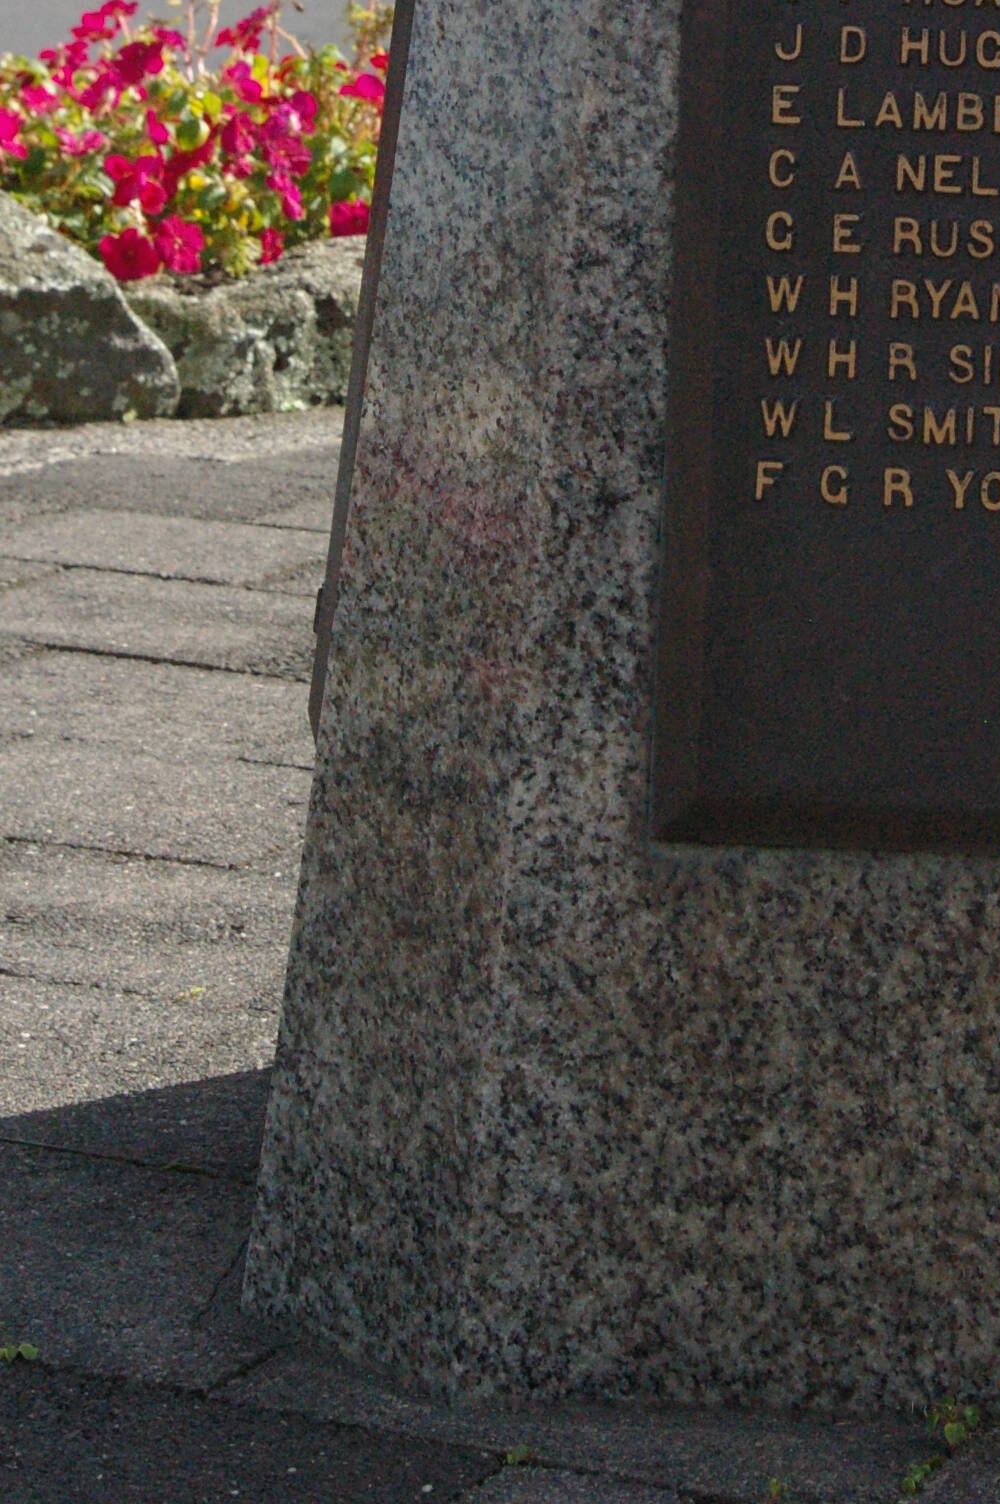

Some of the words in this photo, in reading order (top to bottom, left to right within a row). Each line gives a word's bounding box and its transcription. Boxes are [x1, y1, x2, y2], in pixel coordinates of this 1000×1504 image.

[774, 24, 802, 61] J
[840, 26, 867, 63] D
[771, 85, 800, 124] E
[768, 149, 796, 187] C
[834, 152, 860, 189] A
[766, 211, 794, 250] G
[832, 214, 860, 253] E
[766, 276, 804, 312] W
[829, 277, 858, 316] H
[765, 338, 801, 375] W
[828, 340, 856, 378] H
[888, 343, 917, 381] R
[761, 400, 797, 437] W
[823, 402, 851, 440] L
[755, 462, 784, 500] F
[820, 466, 848, 504] G
[883, 468, 914, 507] R
